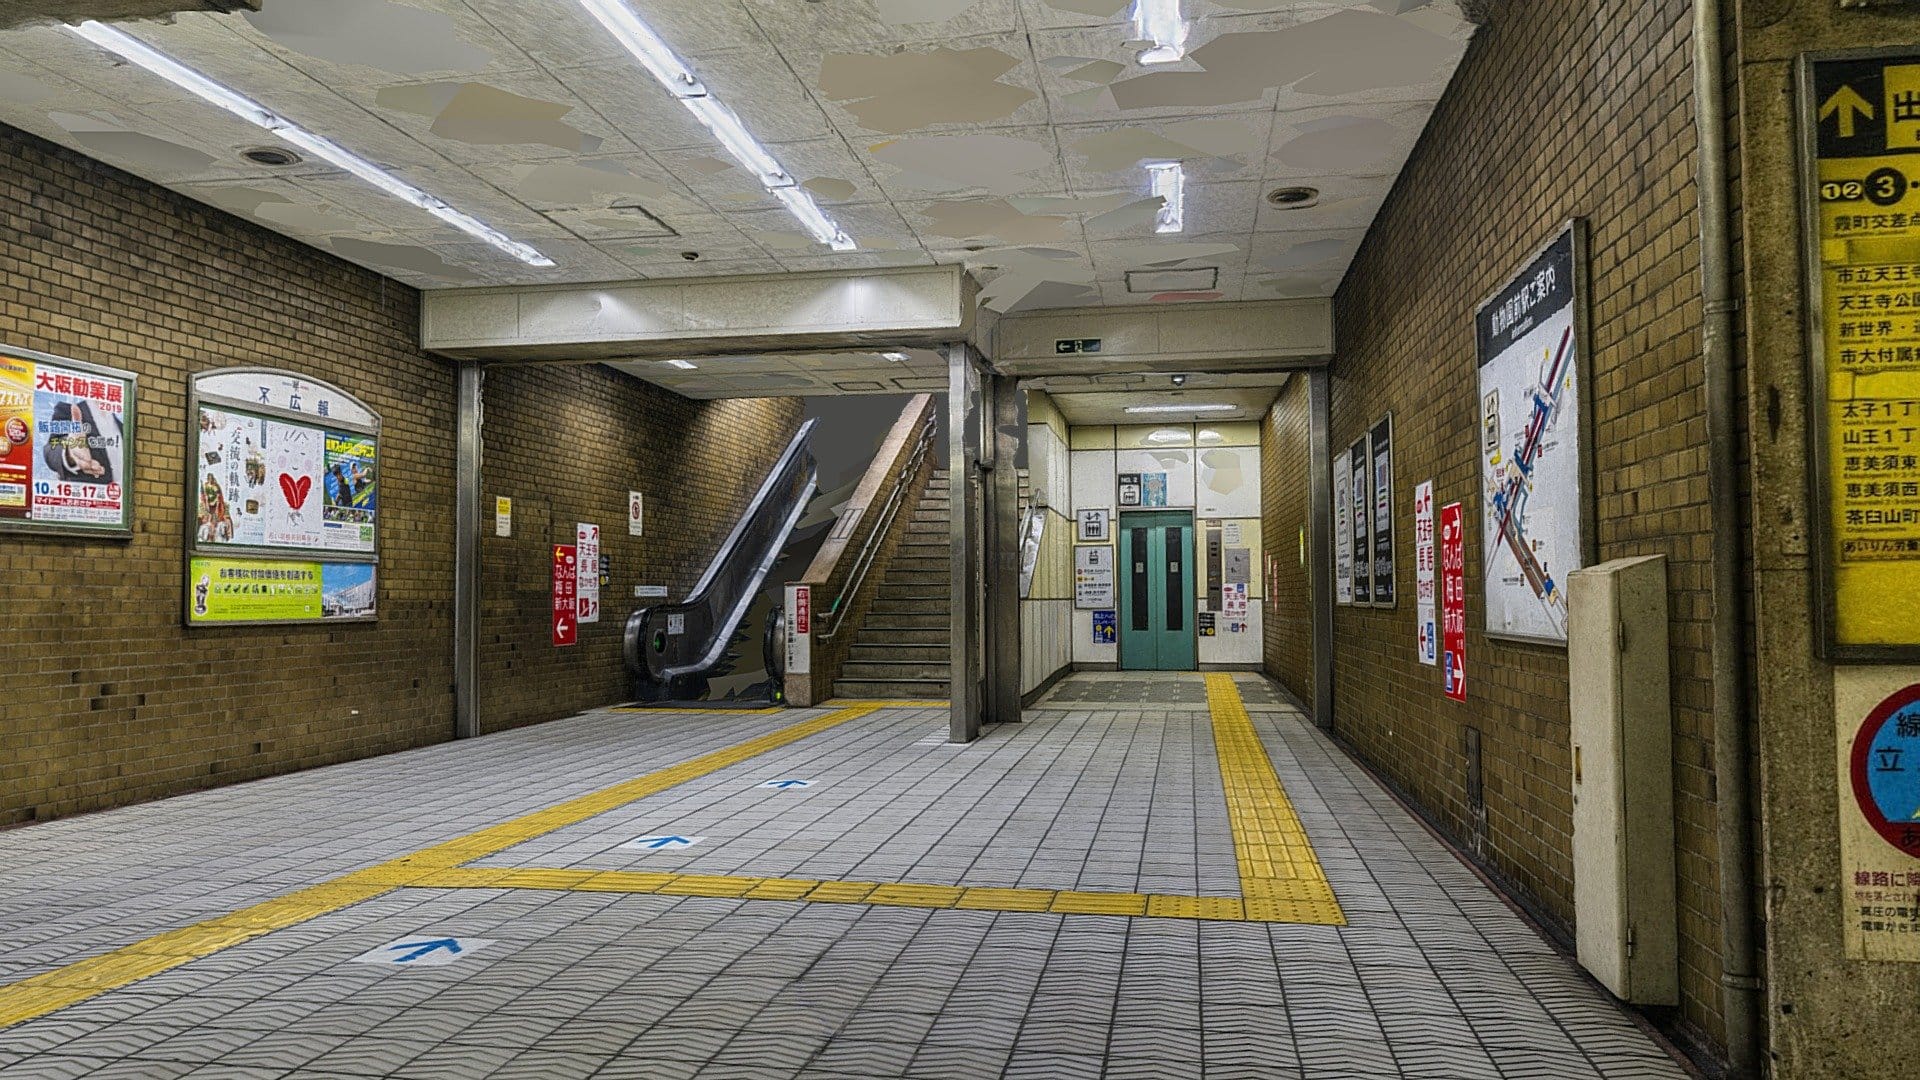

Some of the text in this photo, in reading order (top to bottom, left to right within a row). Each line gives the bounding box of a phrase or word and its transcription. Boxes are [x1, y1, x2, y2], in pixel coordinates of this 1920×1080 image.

[1491, 261, 1556, 339] 動物園前駅ご案内
[36, 372, 122, 403] 大阪勧業展
[100, 402, 122, 413] 2019
[1841, 402, 1920, 418] 太子1丁
[34, 481, 50, 495] 10
[57, 483, 72, 497] 16
[82, 485, 97, 498] 17
[1845, 508, 1920, 525] 茶臼山町
[1417, 516, 1433, 543] 天王寺
[579, 541, 598, 557] 天王寺
[555, 597, 576, 611] 新大阪
[1444, 607, 1464, 634] 新大阪
